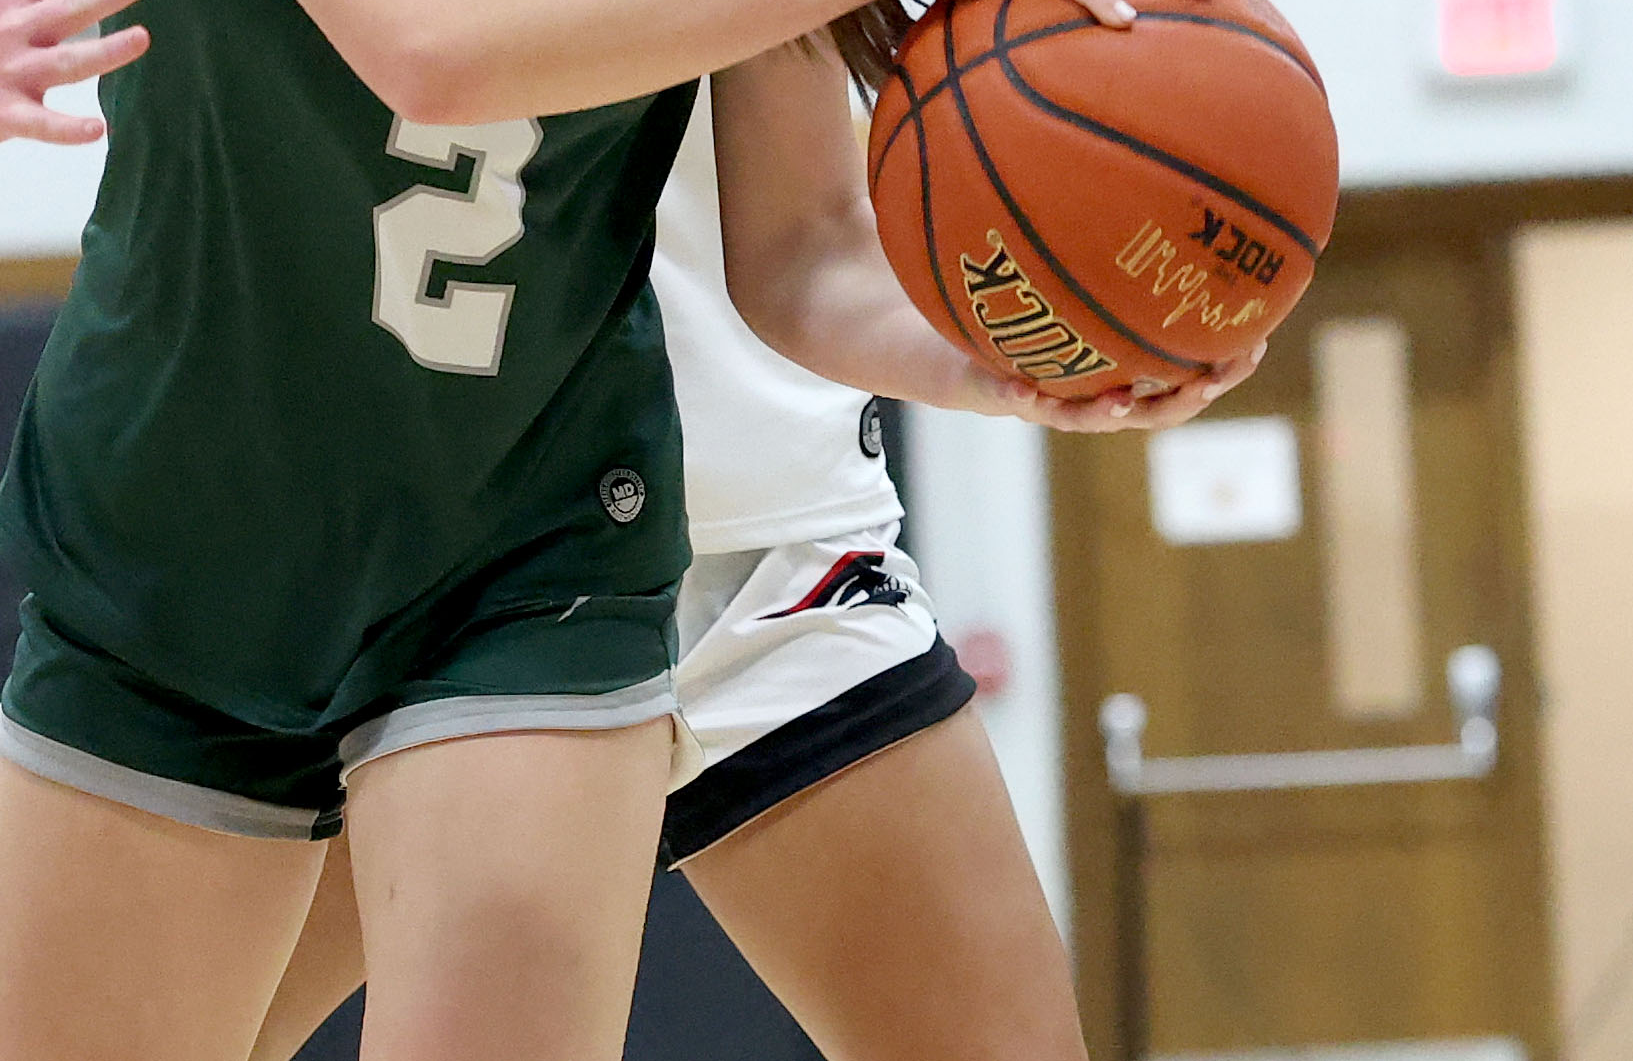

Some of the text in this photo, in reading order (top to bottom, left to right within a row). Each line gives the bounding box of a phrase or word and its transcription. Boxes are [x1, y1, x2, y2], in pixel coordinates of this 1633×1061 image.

[371, 116, 544, 377] 2
[1188, 207, 1286, 286] ROCK
[960, 241, 1118, 382] ROCK
[612, 483, 635, 500] MD
